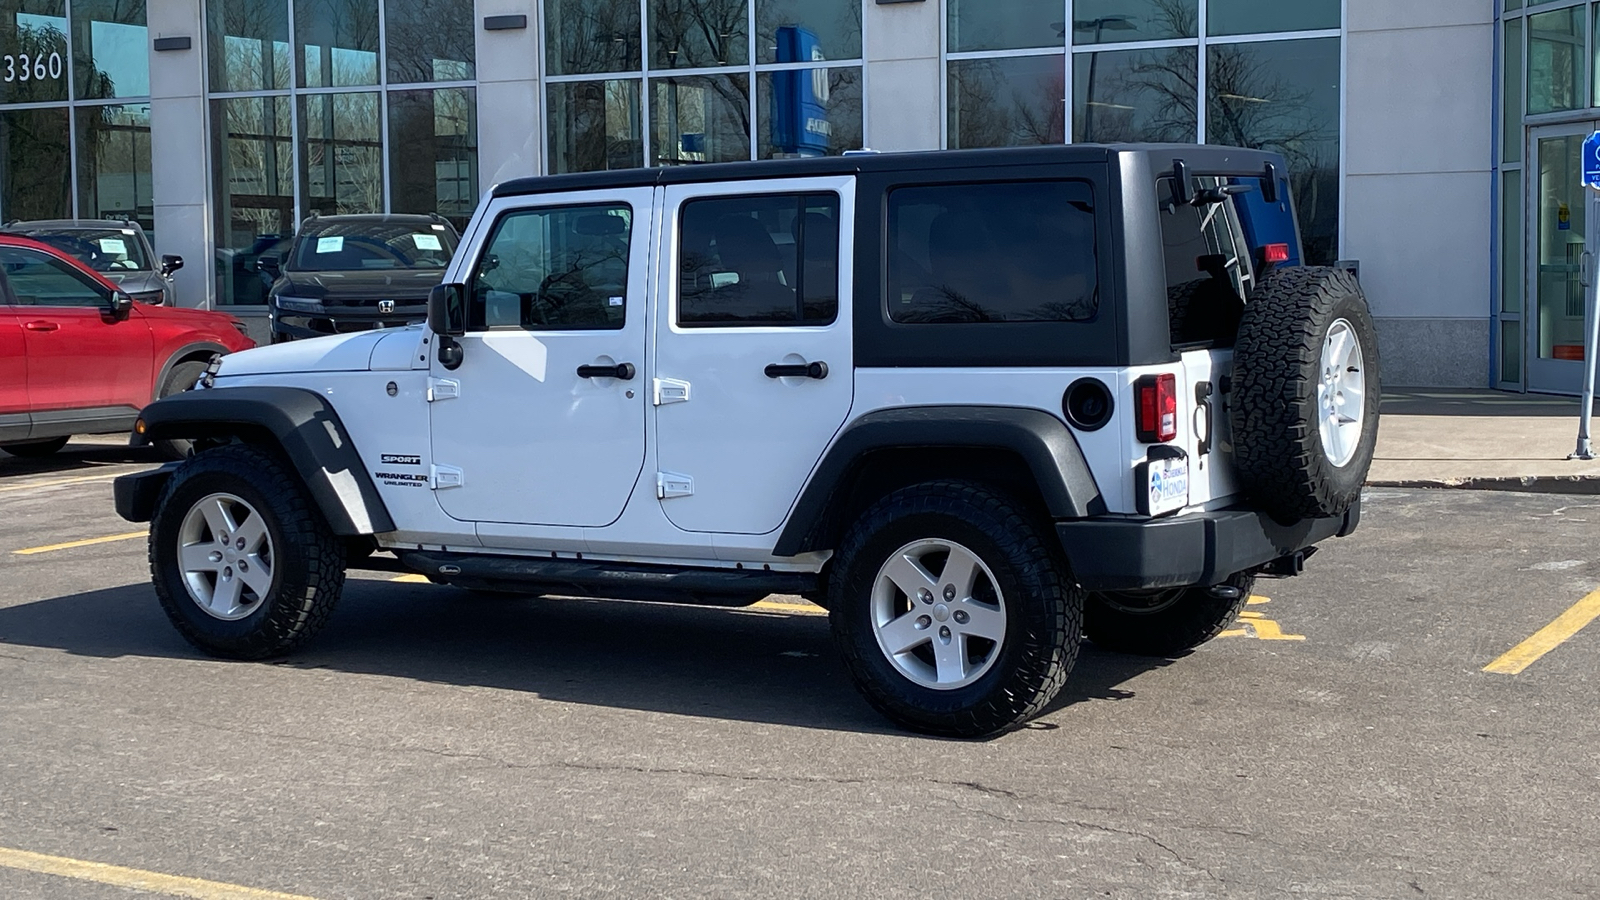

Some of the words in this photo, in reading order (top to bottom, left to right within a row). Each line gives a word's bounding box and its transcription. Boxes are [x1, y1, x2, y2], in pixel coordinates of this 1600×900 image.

[4, 52, 61, 82] 3360
[375, 472, 428, 482] WRANGLER
[1163, 479, 1186, 497] HONDA
